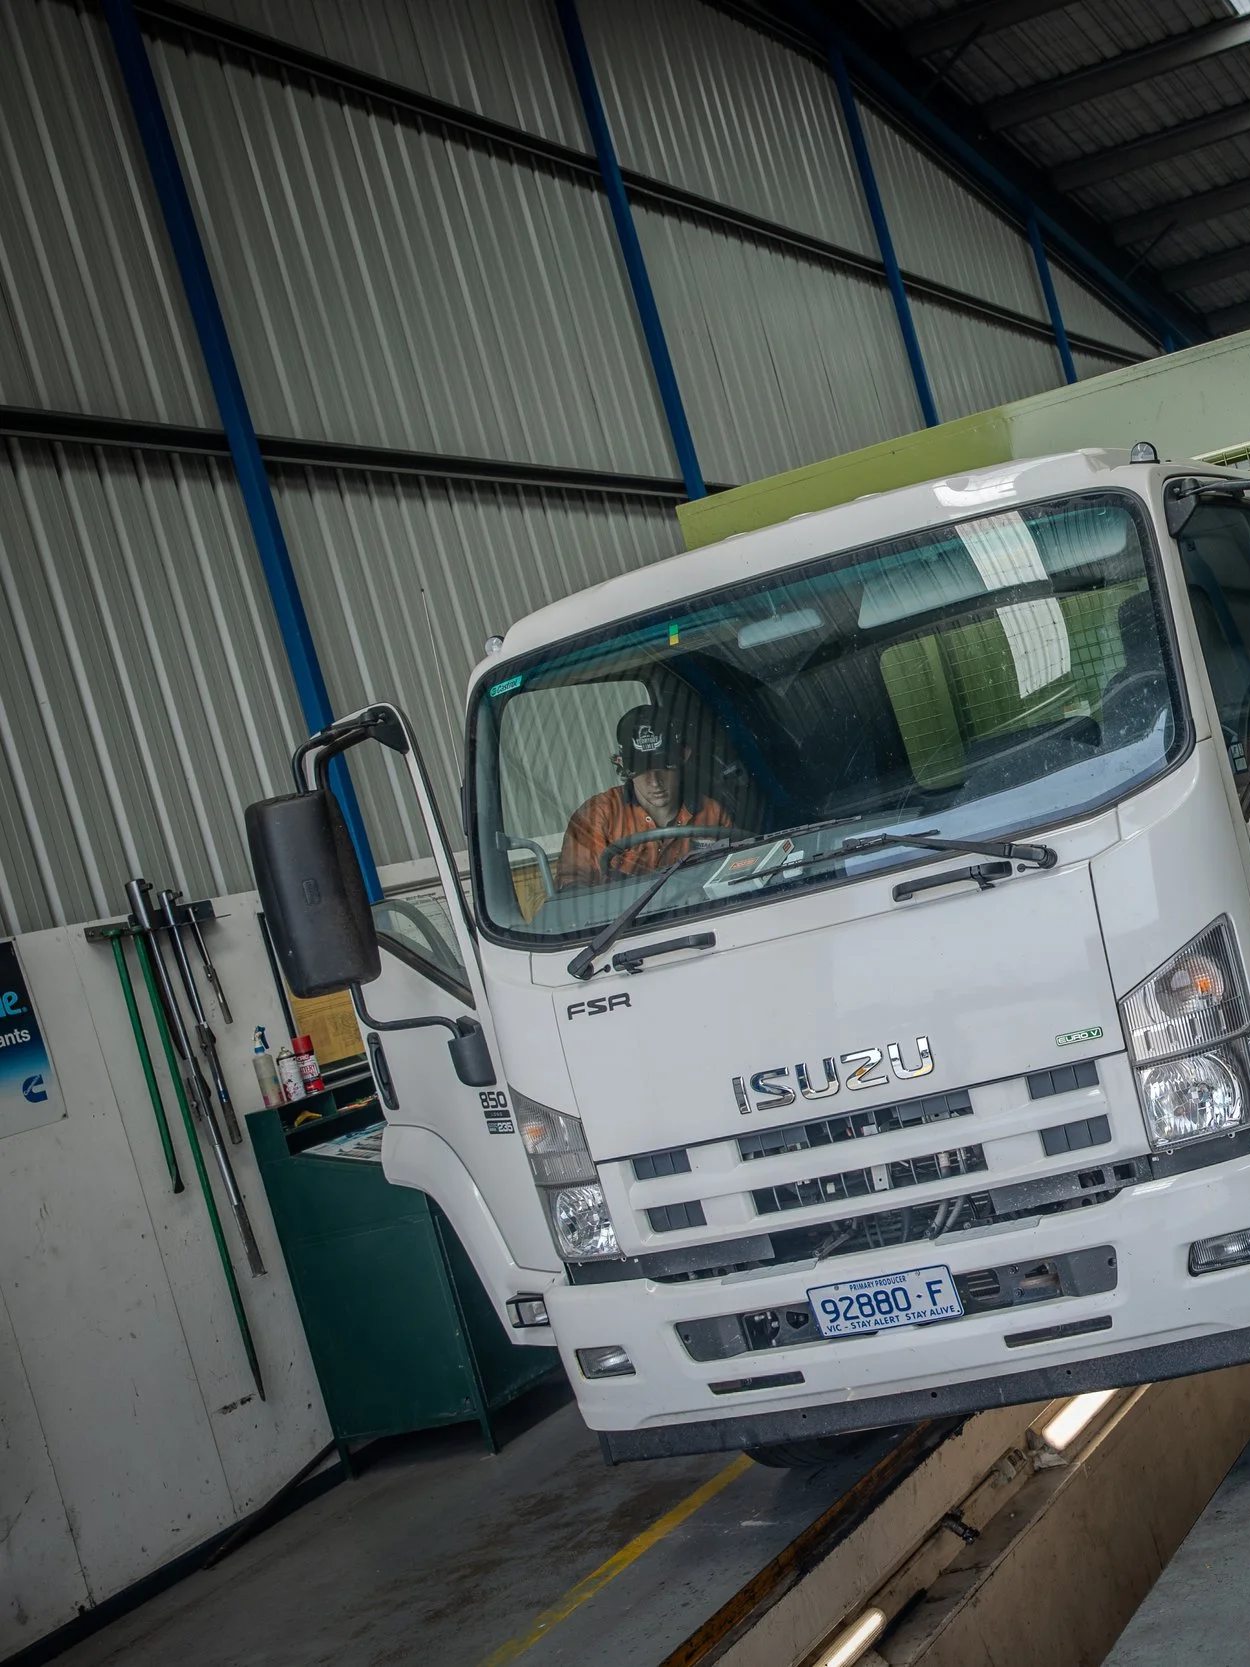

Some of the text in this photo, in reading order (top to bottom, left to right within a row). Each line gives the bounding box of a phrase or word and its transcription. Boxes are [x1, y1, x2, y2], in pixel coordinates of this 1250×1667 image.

[567, 992, 632, 1021] FSR
[1058, 1032, 1089, 1043] EURO
[731, 1035, 935, 1115] ISUZU
[479, 1091, 508, 1109] 850
[497, 1122, 513, 1132] 235
[849, 1275, 907, 1292] PRIMARY PRODUCER
[826, 1324, 842, 1333] VIC
[851, 1320, 872, 1330] STAY
[874, 1315, 900, 1326] ALERT
[905, 1310, 927, 1321] STAY
[929, 1305, 956, 1317] ALIVE
